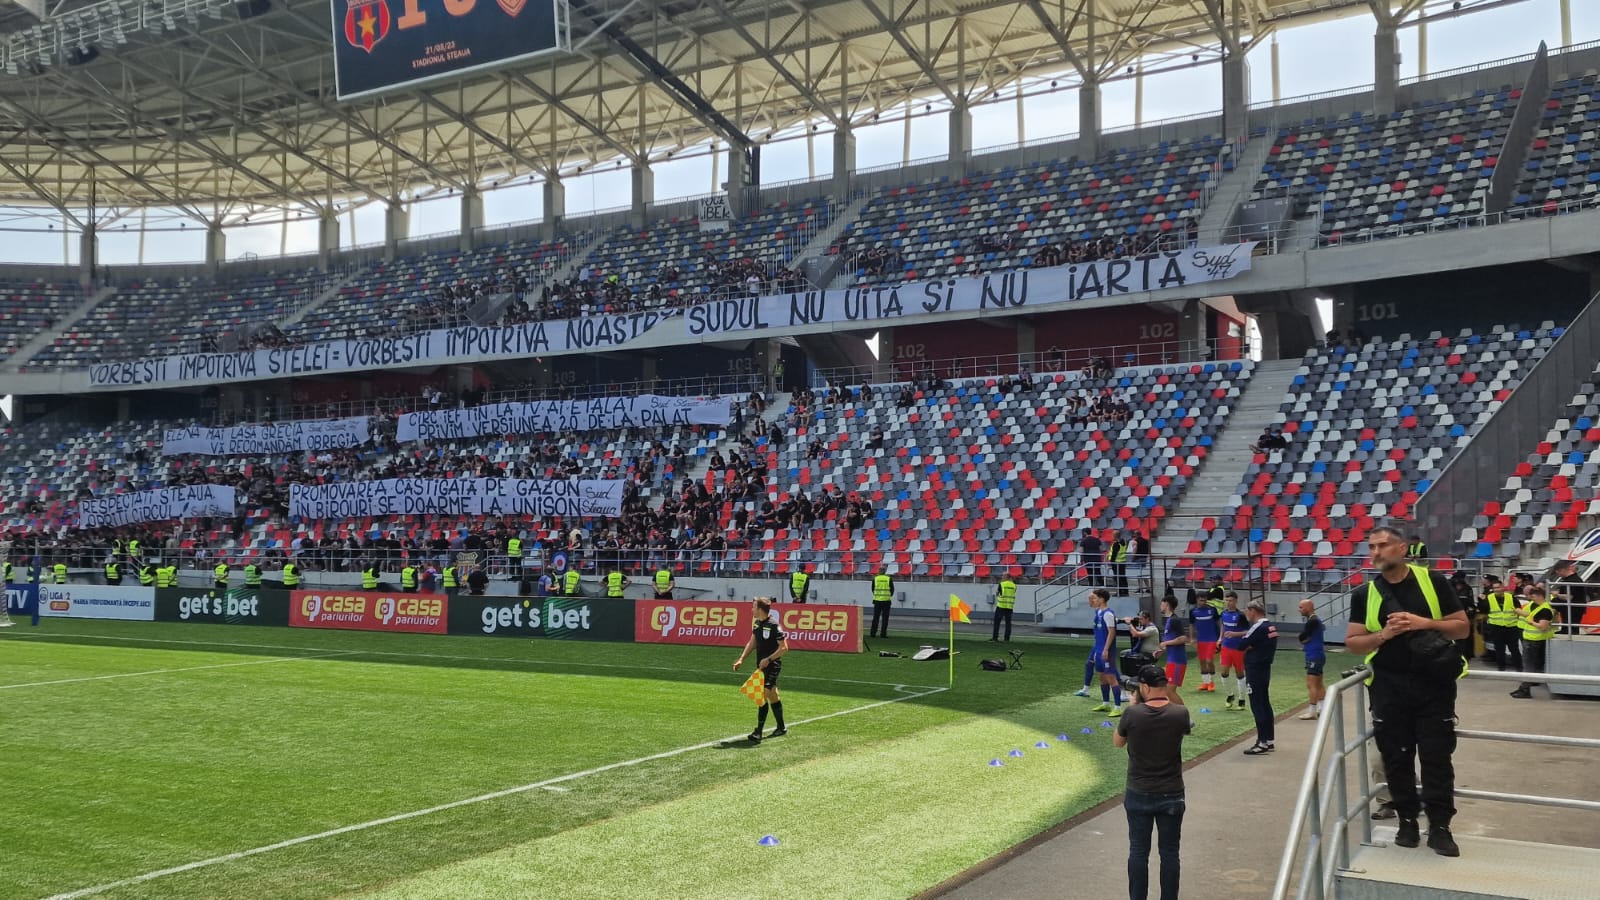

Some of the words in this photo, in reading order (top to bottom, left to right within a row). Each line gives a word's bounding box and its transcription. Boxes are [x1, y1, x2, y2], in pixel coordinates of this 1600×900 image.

[412, 54, 445, 68] STADIONUL
[446, 48, 471, 60] STEAUA
[689, 297, 769, 335] SUDUL
[790, 289, 825, 326] NU
[980, 271, 1028, 309] NU
[1359, 302, 1399, 321] 101
[1139, 322, 1175, 339] 102
[896, 344, 926, 359] 102
[727, 358, 752, 372] 103
[553, 371, 577, 384] 103
[559, 416, 578, 430] 2.0
[589, 413, 607, 429] DE
[613, 412, 634, 428] LA
[641, 408, 692, 427] PALAT
[292, 480, 387, 502] PROMOVAREA
[486, 478, 507, 496] PE
[516, 479, 580, 497] GAZON
[378, 495, 398, 514] SE
[404, 496, 471, 516] DOARME
[480, 497, 502, 516] LA
[5, 589, 28, 608] TV
[50, 592, 63, 600] LIGA
[227, 593, 258, 616] bet
[323, 596, 366, 612] casa
[397, 598, 442, 616] casa
[548, 602, 590, 629] bet
[680, 607, 738, 626] casa
[321, 613, 364, 622] pariurilor
[395, 616, 440, 625] pariurilor
[783, 609, 848, 631] casa
[678, 626, 735, 637] pariurilor
